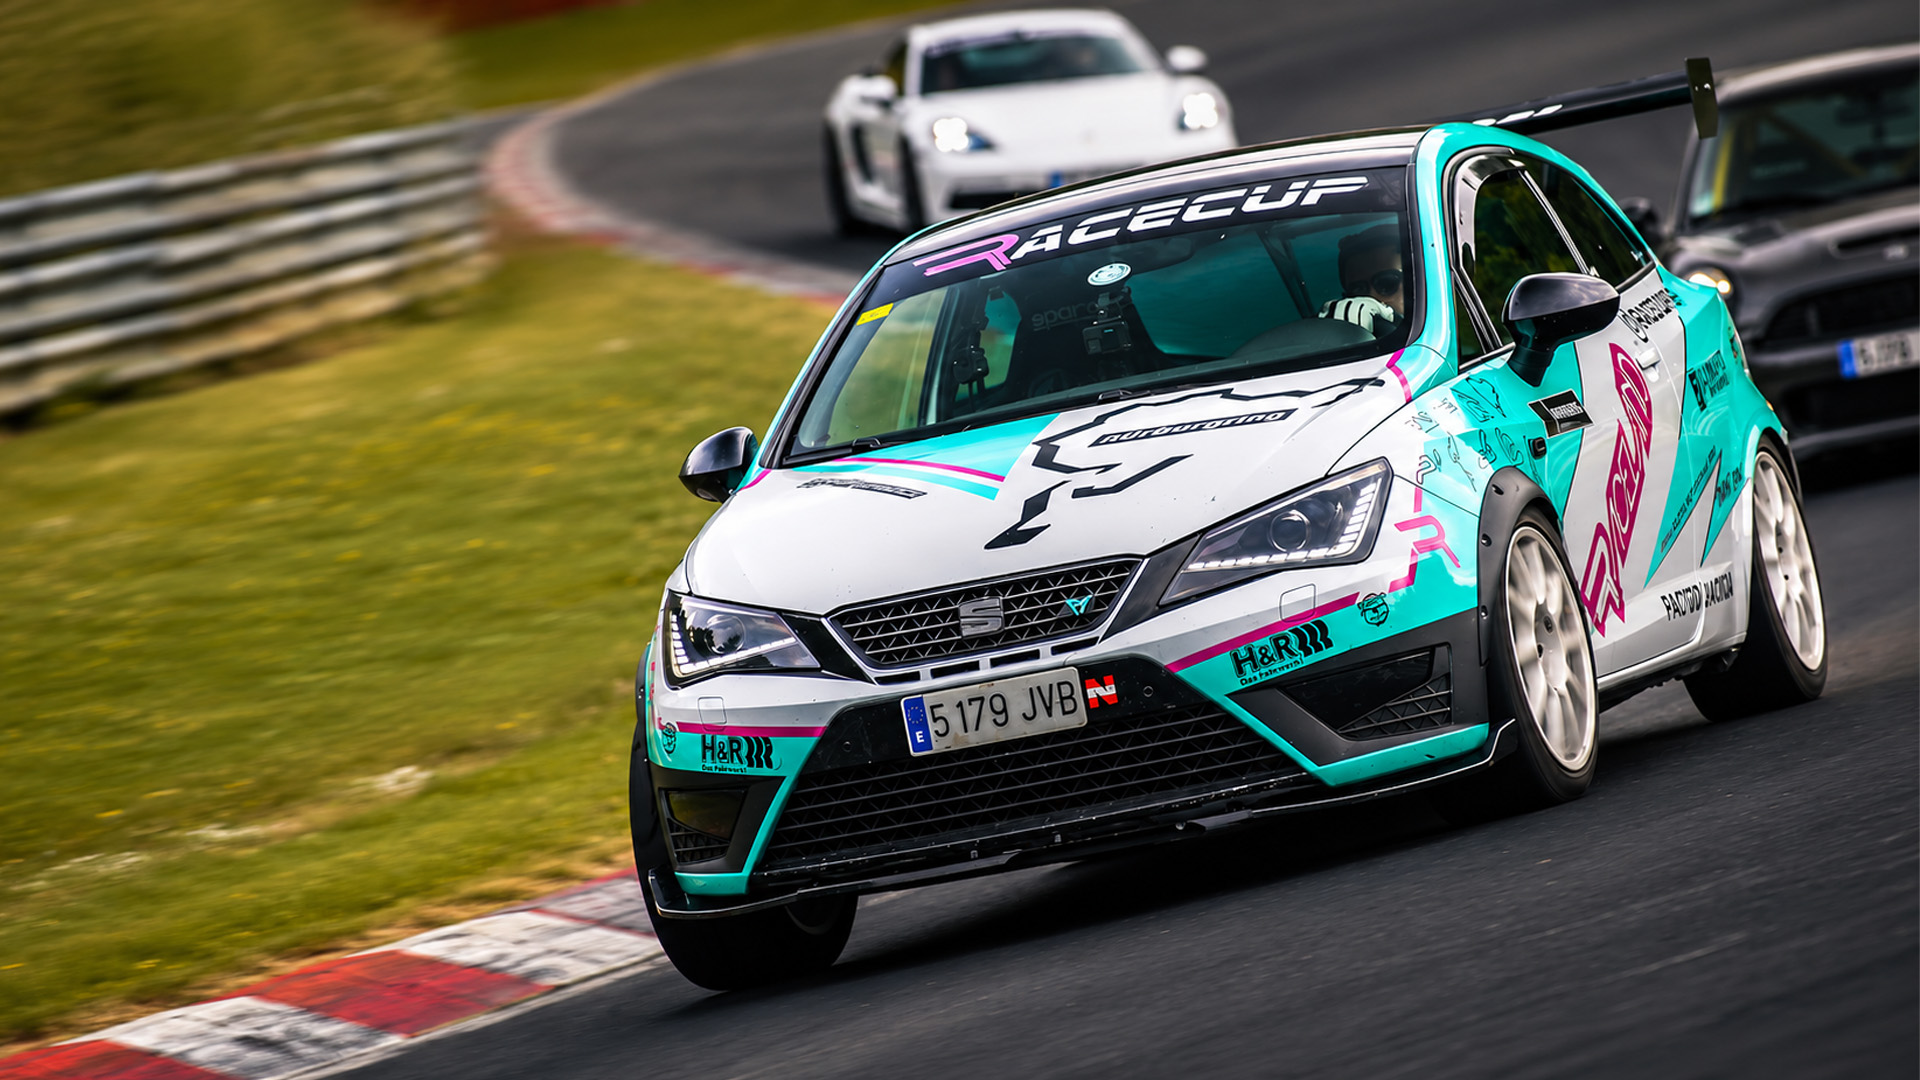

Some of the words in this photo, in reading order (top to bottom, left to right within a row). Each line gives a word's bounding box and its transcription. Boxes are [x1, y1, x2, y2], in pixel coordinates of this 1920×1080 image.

[913, 176, 1369, 276] RACECUP
[1229, 628, 1305, 679] H&R
[929, 693, 1009, 738] 5179
[1022, 680, 1078, 722] JVB
[701, 734, 748, 766] H&R
[915, 730, 925, 744] E
